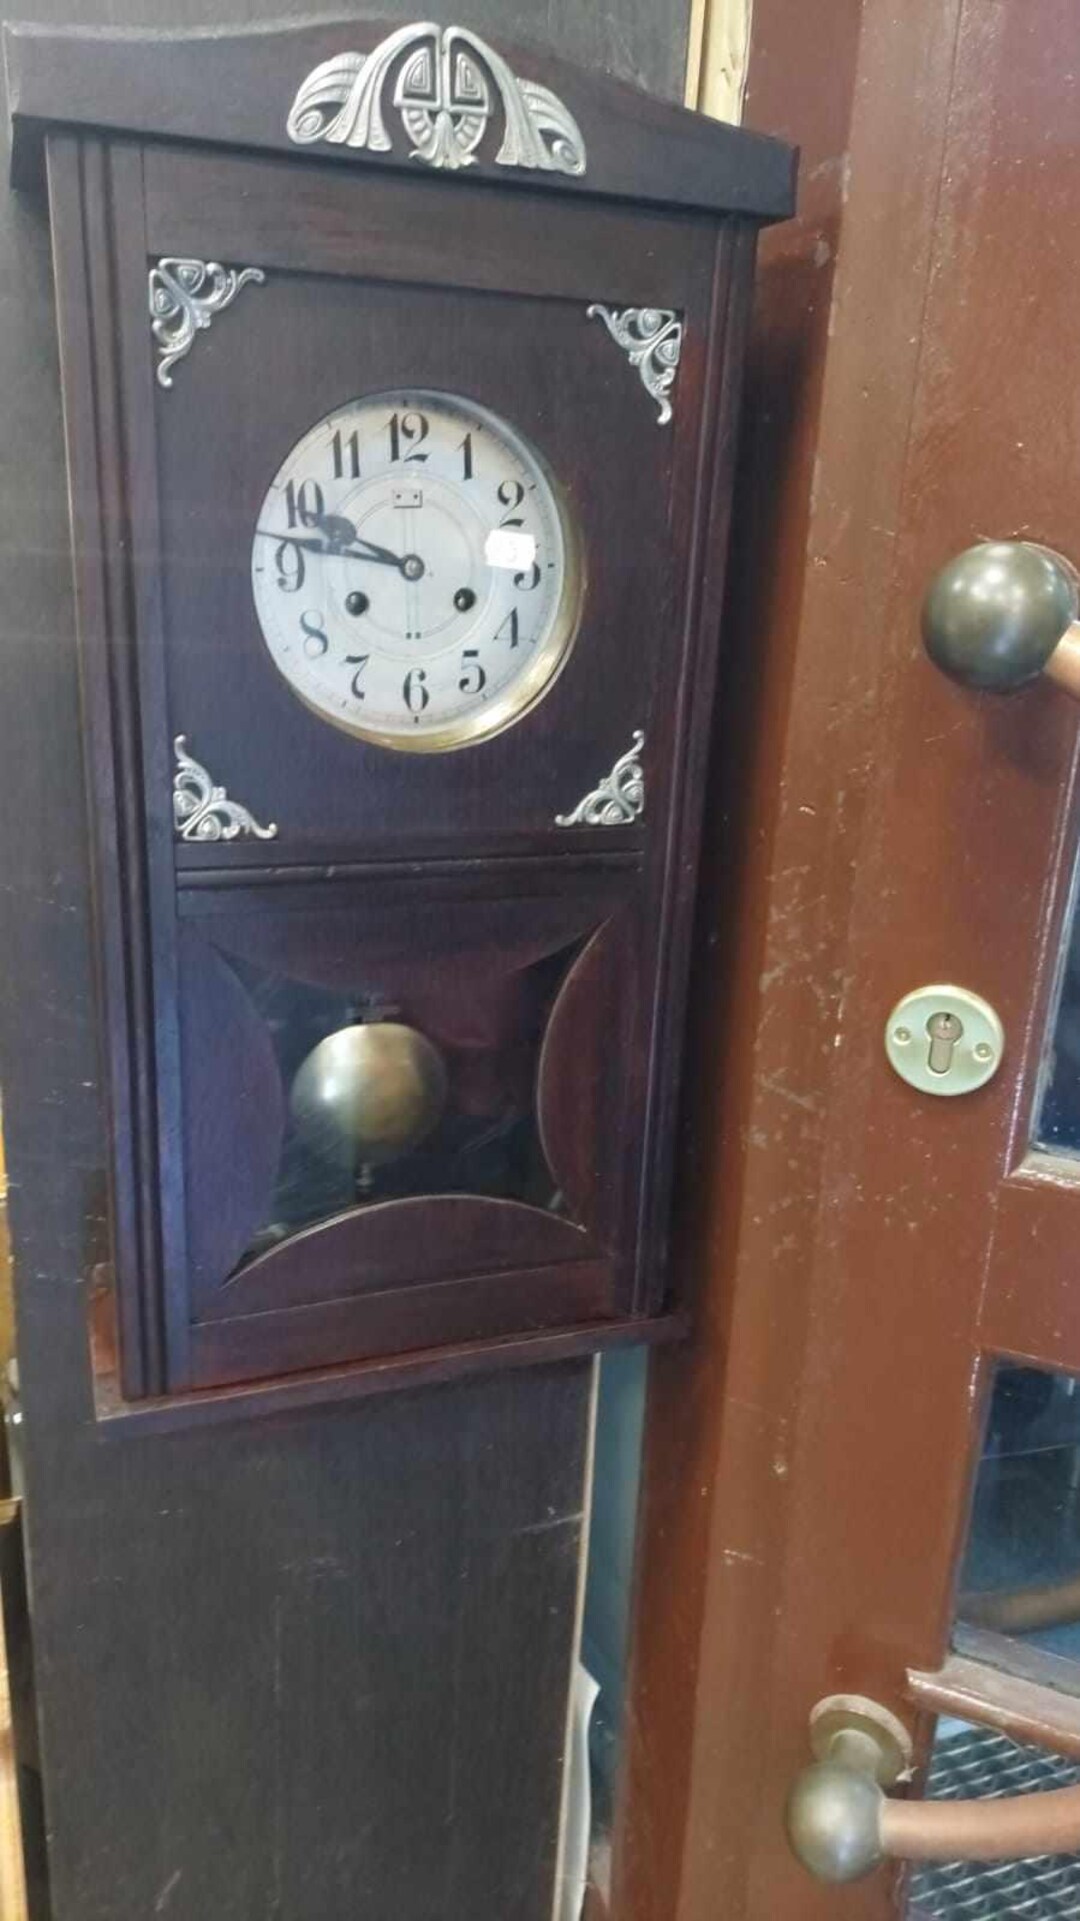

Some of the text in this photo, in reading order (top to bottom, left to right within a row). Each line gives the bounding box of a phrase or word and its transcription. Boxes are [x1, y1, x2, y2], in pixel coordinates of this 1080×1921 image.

[328, 429, 360, 479] 11
[382, 412, 429, 463] 12
[456, 432, 473, 481] 1
[282, 478, 325, 529] 10
[497, 480, 526, 528] 2
[275, 540, 306, 592] 9
[299, 609, 329, 657] 8
[493, 606, 526, 648] 4
[345, 653, 370, 700] 7
[403, 667, 429, 713] 6
[459, 648, 487, 694] 5
